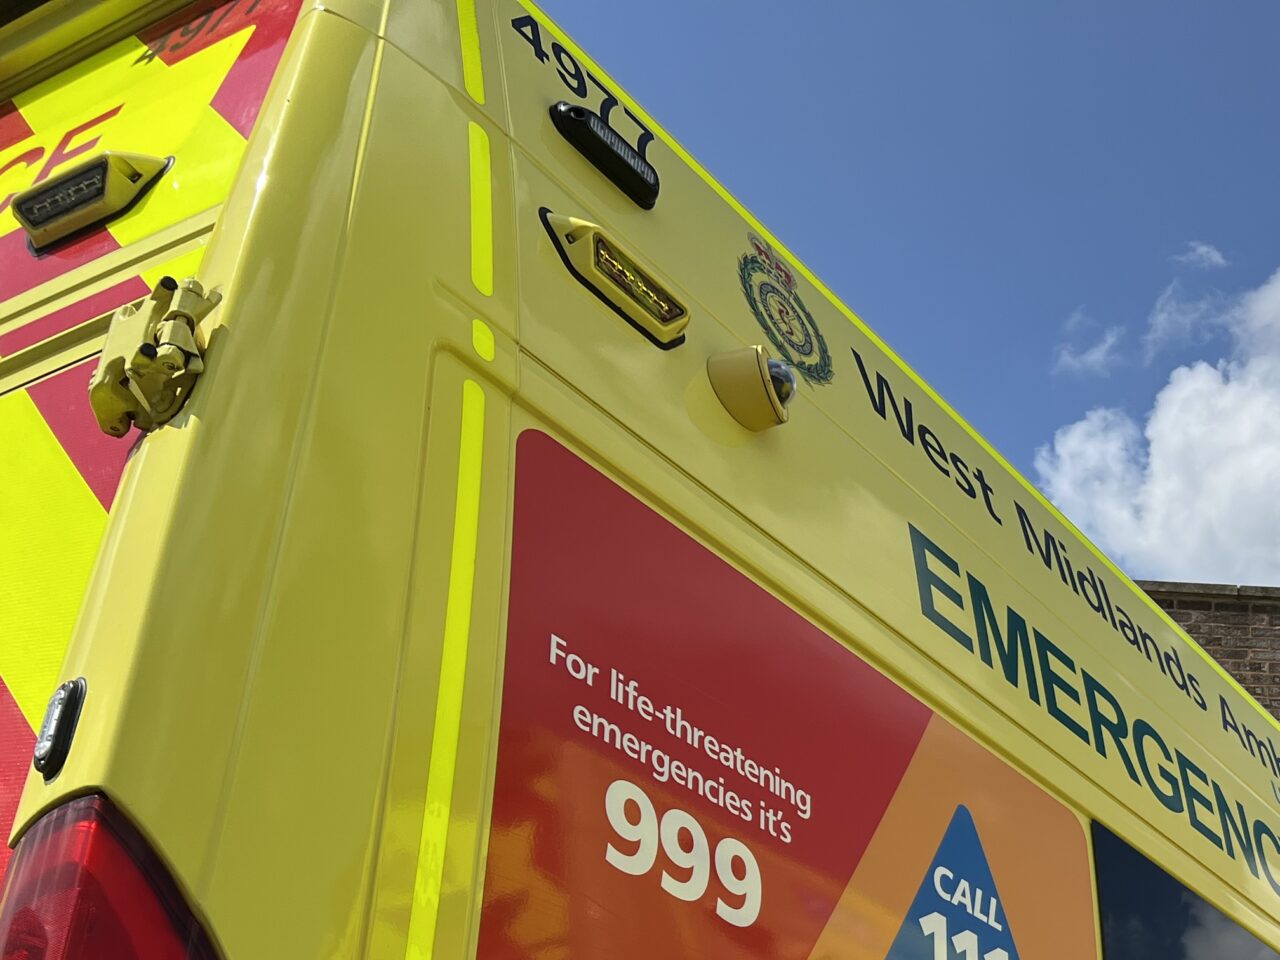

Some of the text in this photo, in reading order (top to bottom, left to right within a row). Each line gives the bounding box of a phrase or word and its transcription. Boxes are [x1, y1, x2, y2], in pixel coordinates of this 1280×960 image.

[511, 15, 655, 159] 4977
[851, 347, 1003, 526] West
[1014, 500, 1208, 711] Midlands
[550, 634, 812, 819] For life-threatening
[572, 705, 792, 844] emergencies it's
[604, 779, 762, 928] 999
[933, 866, 1002, 931] CALL
